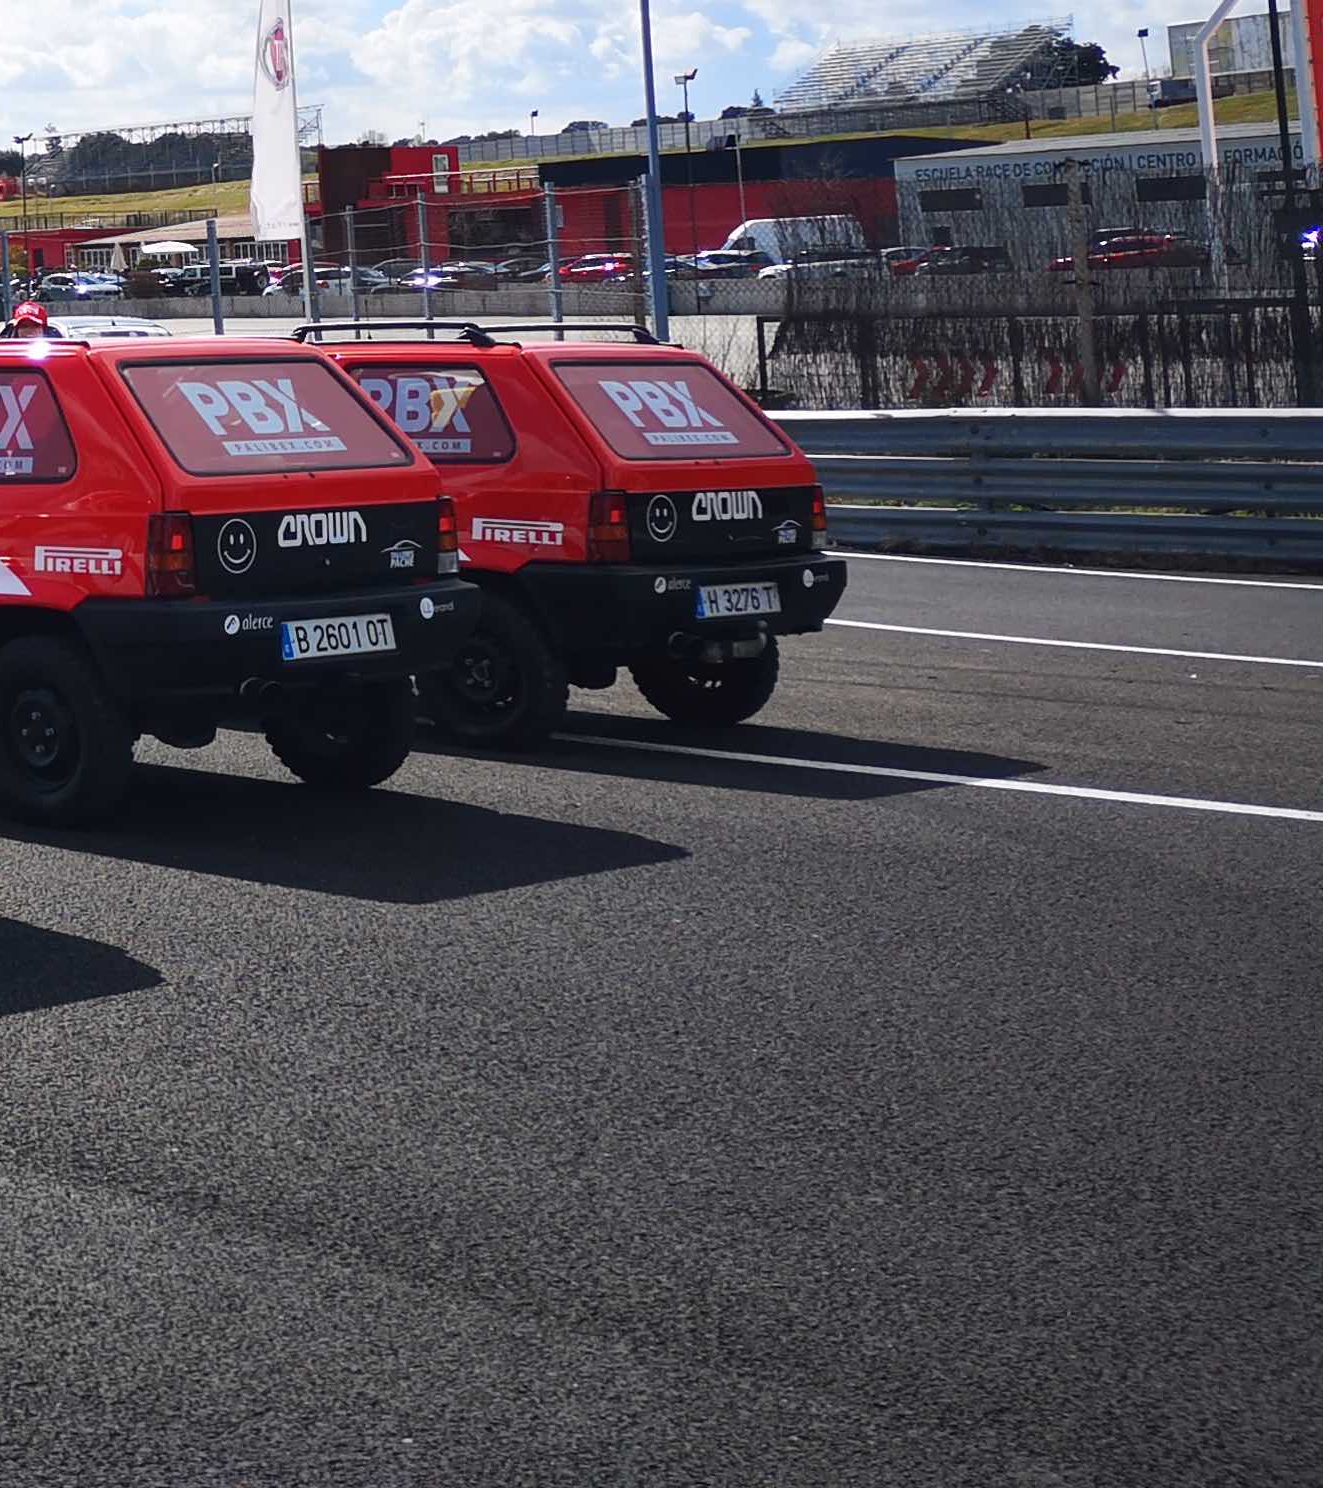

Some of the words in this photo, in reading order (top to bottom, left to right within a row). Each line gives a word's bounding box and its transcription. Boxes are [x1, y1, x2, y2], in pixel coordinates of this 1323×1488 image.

[915, 167, 973, 183] ESCUELA
[977, 163, 1011, 179] RACE
[1013, 162, 1031, 177] DE
[1137, 151, 1196, 170] CENTRO
[176, 379, 331, 435] PBX
[598, 380, 724, 427] PBX
[692, 490, 763, 521] CROWN
[278, 511, 367, 547] CROWN
[472, 517, 564, 545] PIRELLI
[34, 545, 123, 575] PIRELLI
[707, 590, 719, 613] H
[723, 588, 760, 612] 3276
[762, 586, 773, 609] T
[295, 626, 310, 653] B
[313, 622, 362, 650] 2601
